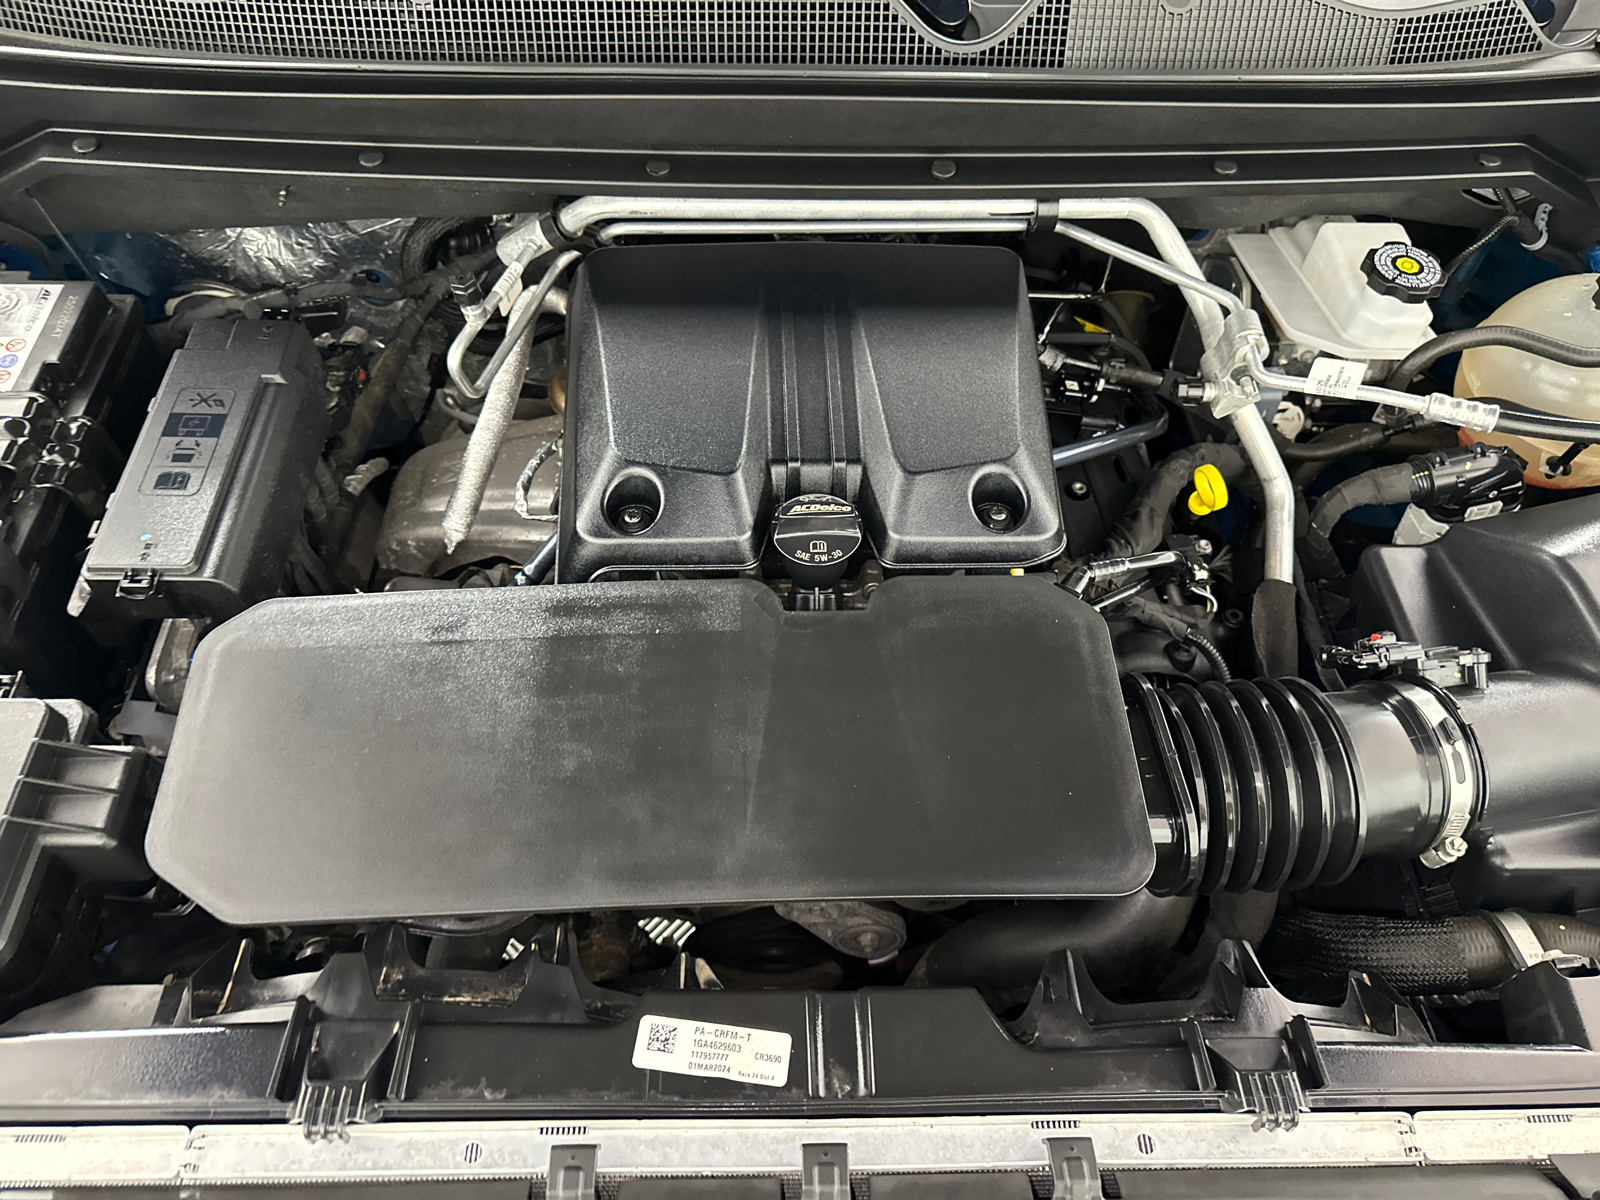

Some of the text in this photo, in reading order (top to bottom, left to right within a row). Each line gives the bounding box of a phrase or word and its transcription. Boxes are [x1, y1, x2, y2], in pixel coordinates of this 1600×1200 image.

[789, 503, 852, 513] ACDelco
[794, 549, 843, 562] SAE 5W-30
[693, 1038, 742, 1053] 1GA4629603
[691, 1050, 729, 1062] 117957777
[754, 1052, 782, 1063] CR3690
[688, 1061, 731, 1073] 01MAR2024
[738, 1070, 750, 1078] Rack
